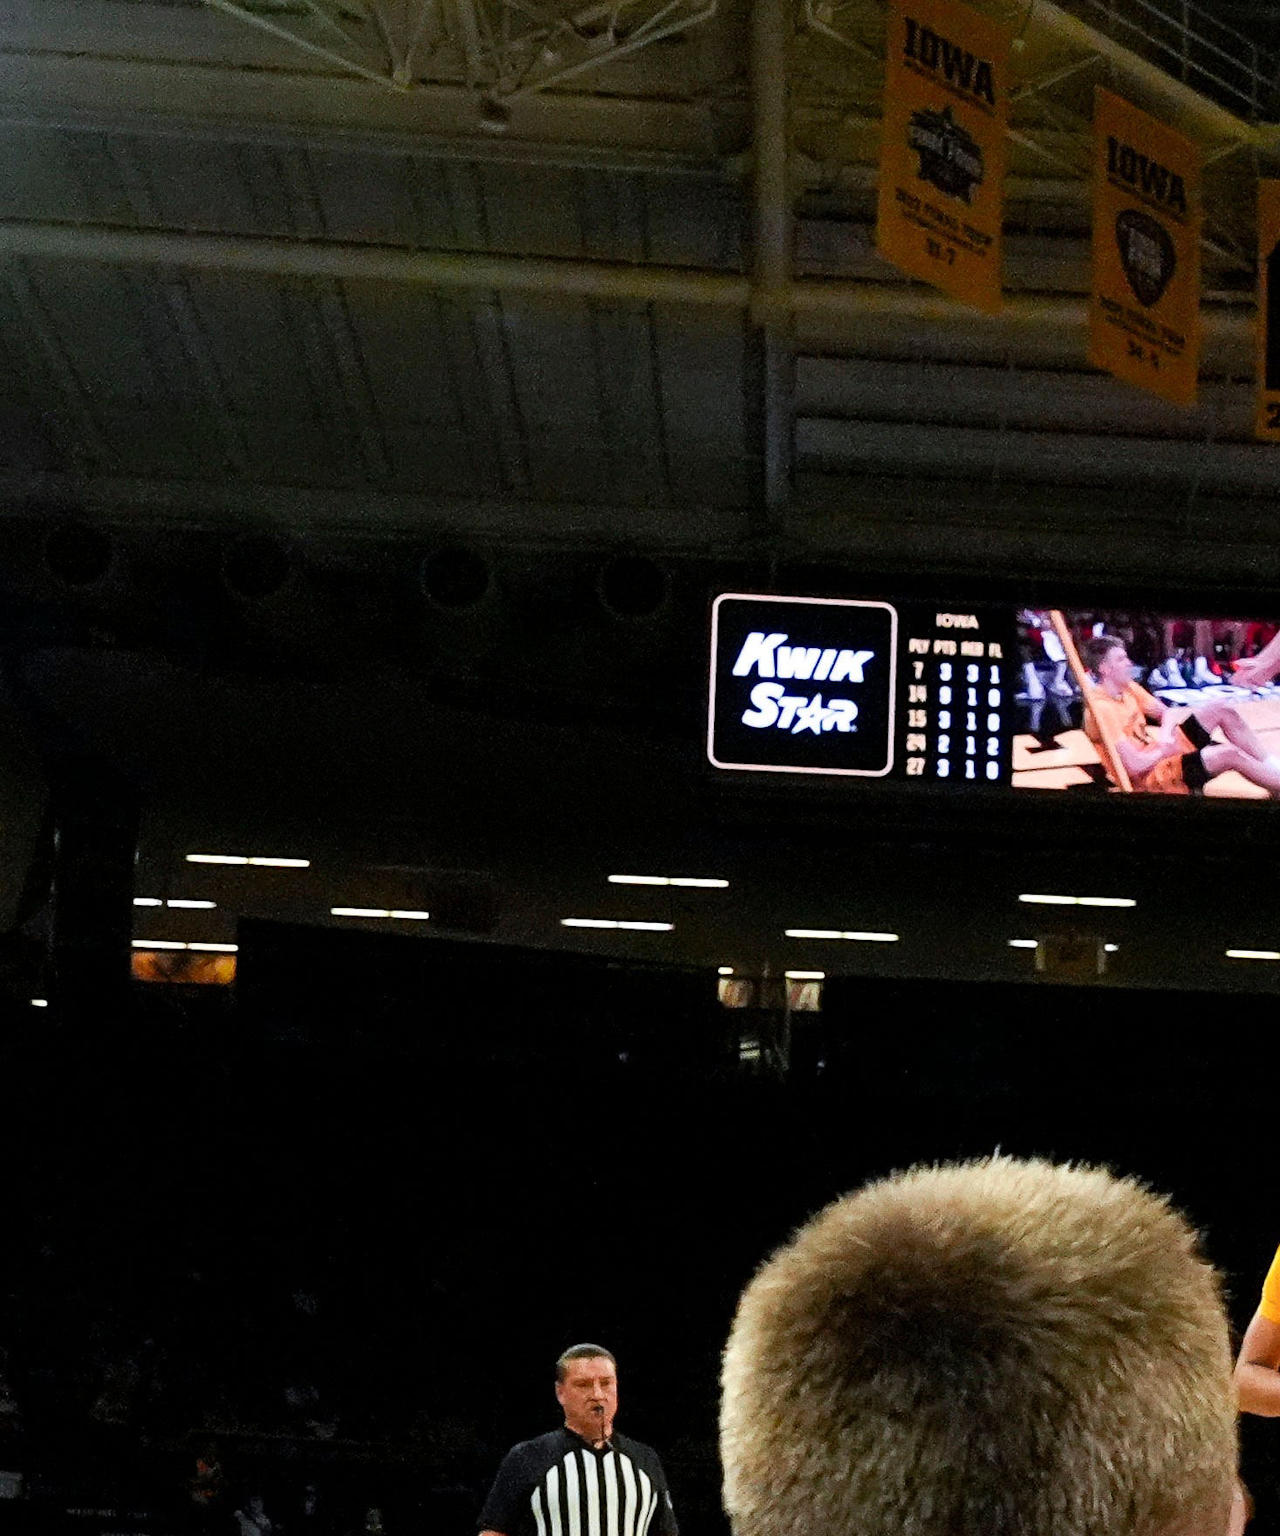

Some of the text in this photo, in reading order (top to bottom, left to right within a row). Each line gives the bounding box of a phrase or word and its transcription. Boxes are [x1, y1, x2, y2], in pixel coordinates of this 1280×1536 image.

[904, 16, 995, 104] IOWA
[1108, 136, 1187, 213] IOWA
[732, 632, 875, 684] KWIK
[990, 665, 1000, 684] 1
[967, 687, 978, 706] 1
[966, 712, 977, 731] 1
[965, 736, 976, 755] 1
[965, 760, 976, 779] 1
